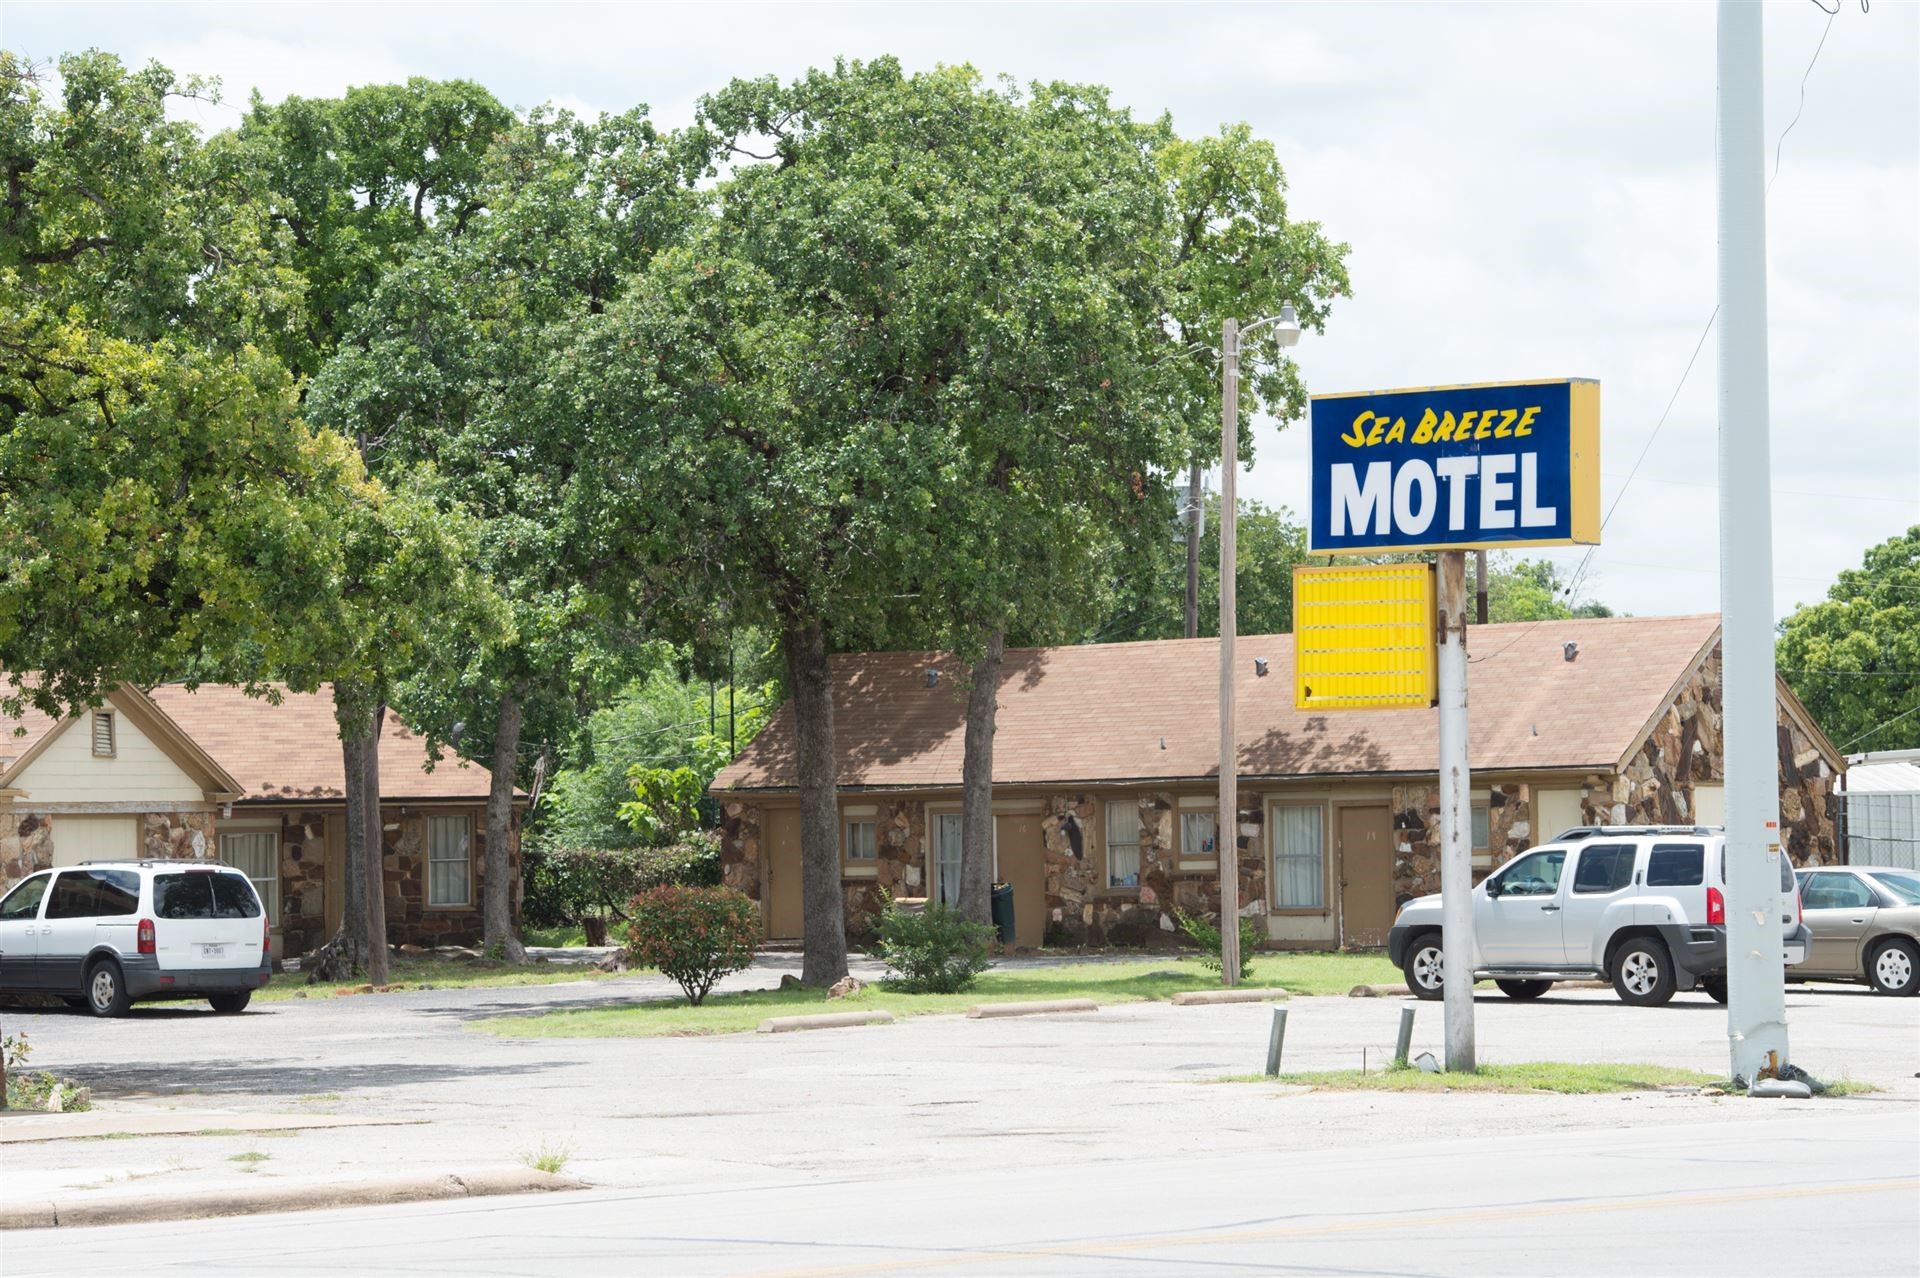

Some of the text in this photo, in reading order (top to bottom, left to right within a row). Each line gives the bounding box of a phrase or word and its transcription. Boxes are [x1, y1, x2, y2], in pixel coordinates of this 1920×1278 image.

[1341, 406, 1541, 447] SEA BREEZE
[1331, 452, 1556, 536] MOTEL
